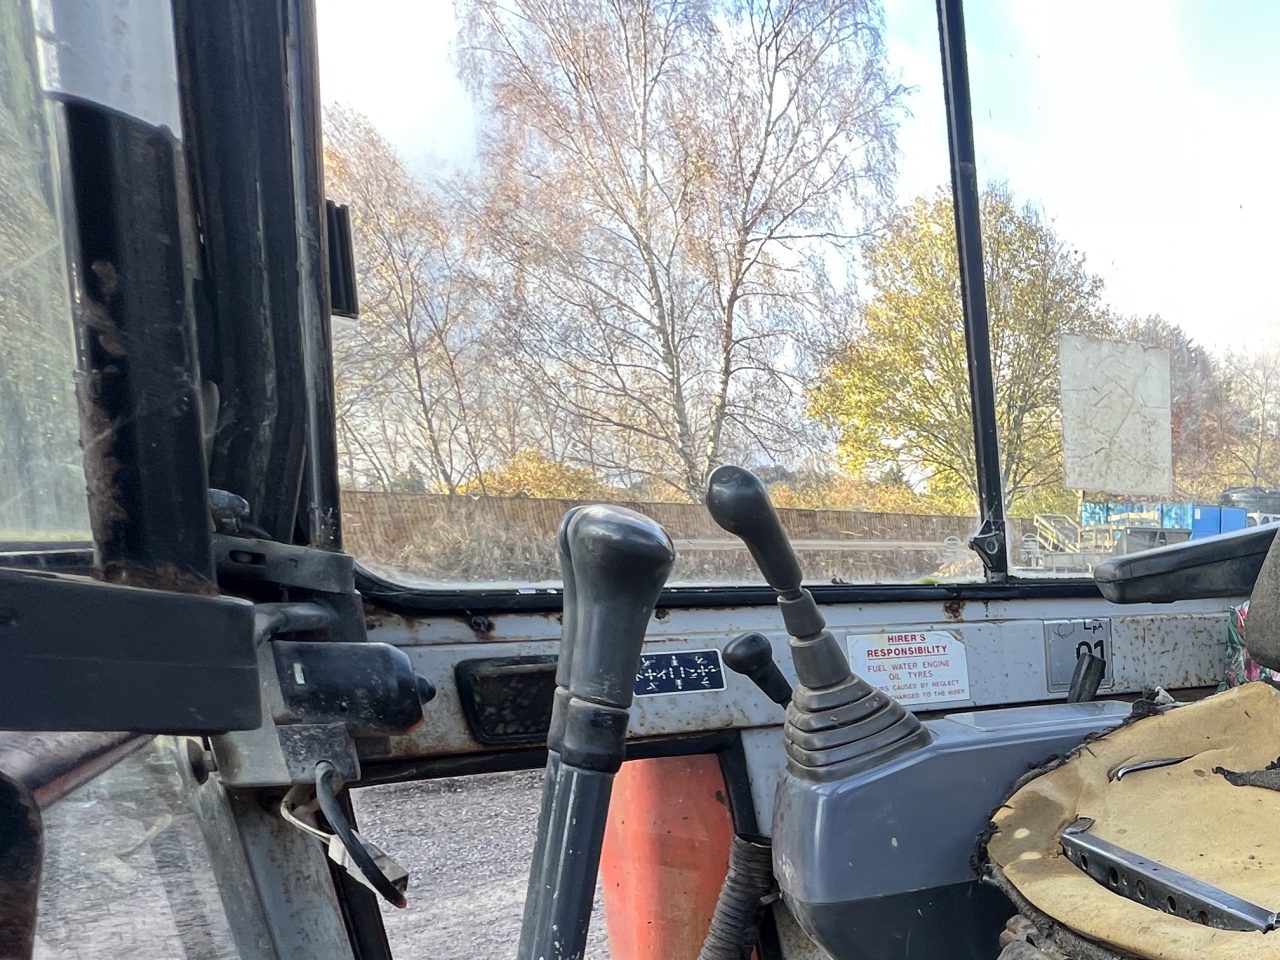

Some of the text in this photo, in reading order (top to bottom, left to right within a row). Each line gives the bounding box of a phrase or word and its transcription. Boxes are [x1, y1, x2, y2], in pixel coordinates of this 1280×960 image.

[887, 634, 926, 643] HIRER'S
[867, 645, 947, 658] RESPONSIBILITY
[867, 659, 950, 673] FUEL WATER ENGINE
[888, 670, 934, 681] OIL TYRES
[892, 683, 917, 691] CAUSED
[931, 679, 960, 687] NEGLECT
